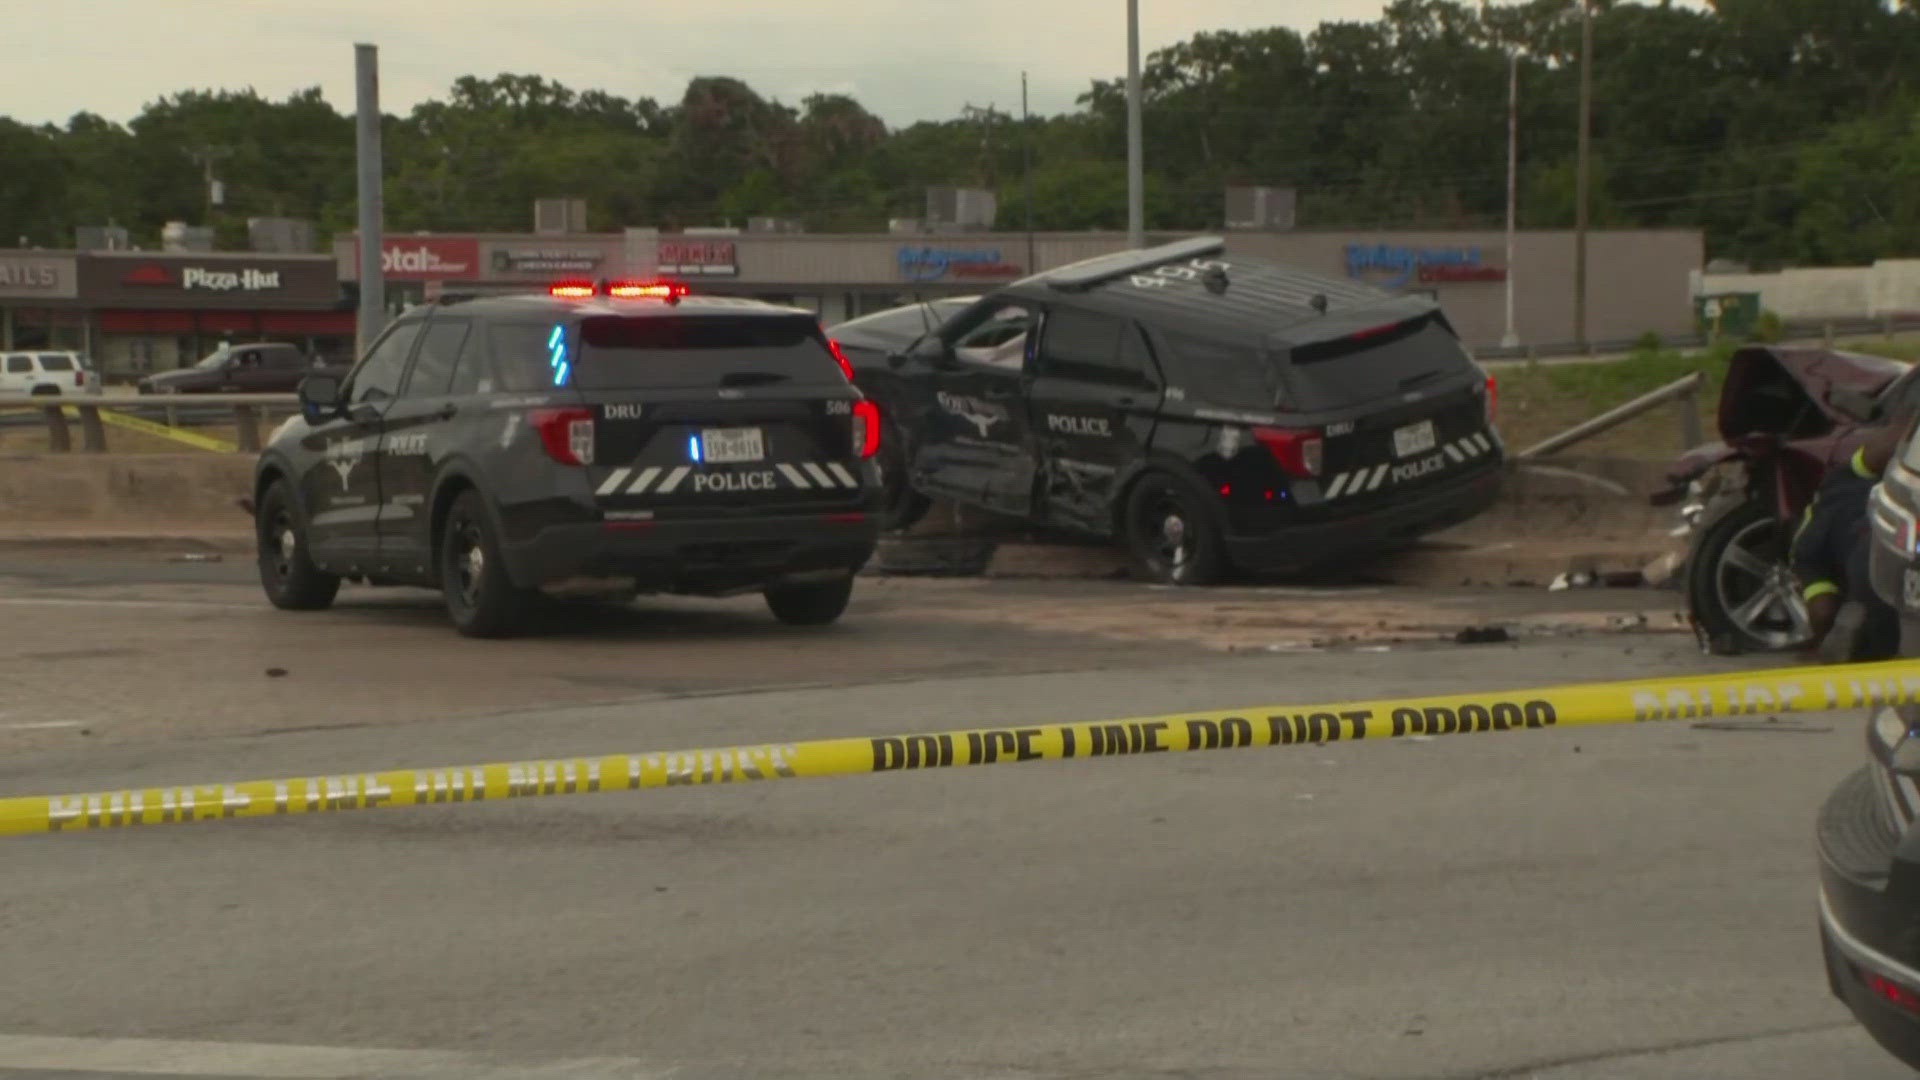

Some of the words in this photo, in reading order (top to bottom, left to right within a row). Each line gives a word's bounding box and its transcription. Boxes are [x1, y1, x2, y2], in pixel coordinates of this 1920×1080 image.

[382, 246, 428, 272] otal
[182, 267, 238, 290] Pizza
[240, 268, 280, 290] Hut
[604, 404, 642, 419] DRU
[826, 400, 850, 415] 506
[1048, 413, 1112, 437] POLICE
[1391, 453, 1445, 484] POLICE
[693, 470, 777, 493] POLICE
